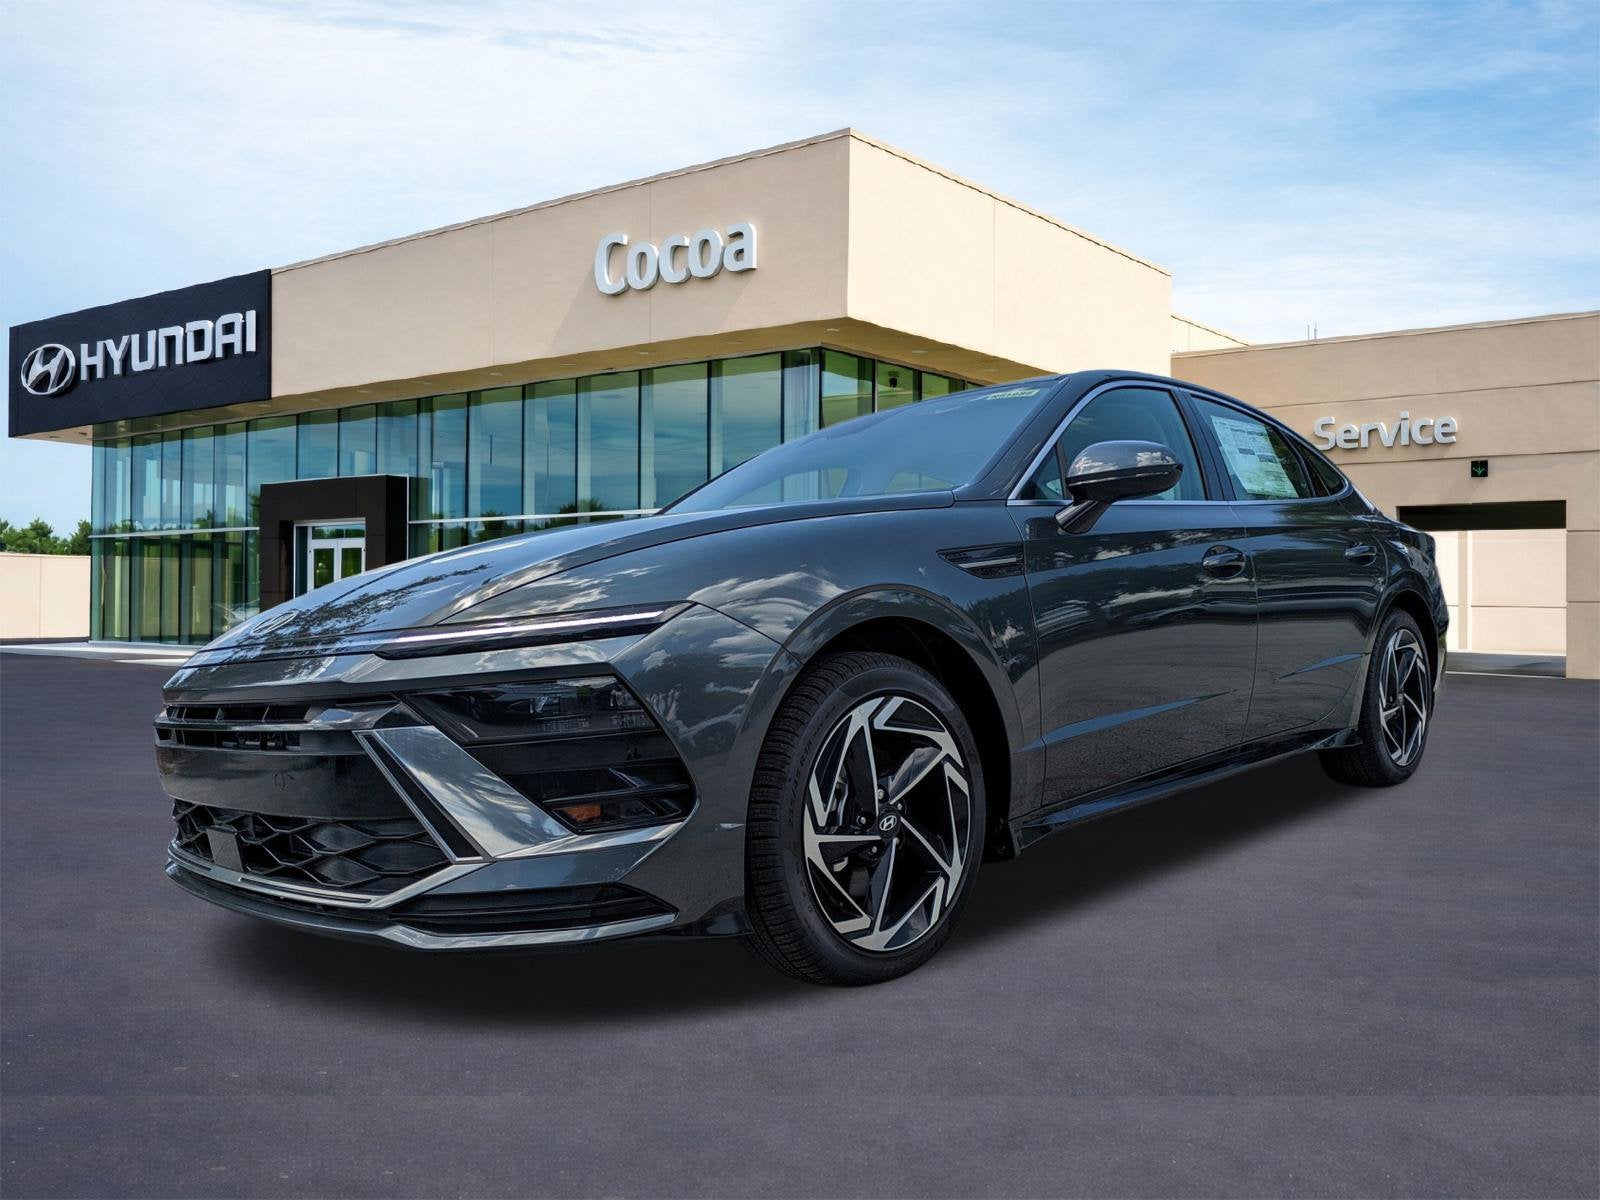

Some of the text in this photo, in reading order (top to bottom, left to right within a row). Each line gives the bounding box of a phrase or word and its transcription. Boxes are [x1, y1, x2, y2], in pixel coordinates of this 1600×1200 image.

[594, 222, 757, 295] Cocoa
[80, 310, 256, 380] HYUNDAI
[1313, 410, 1457, 450] Service
